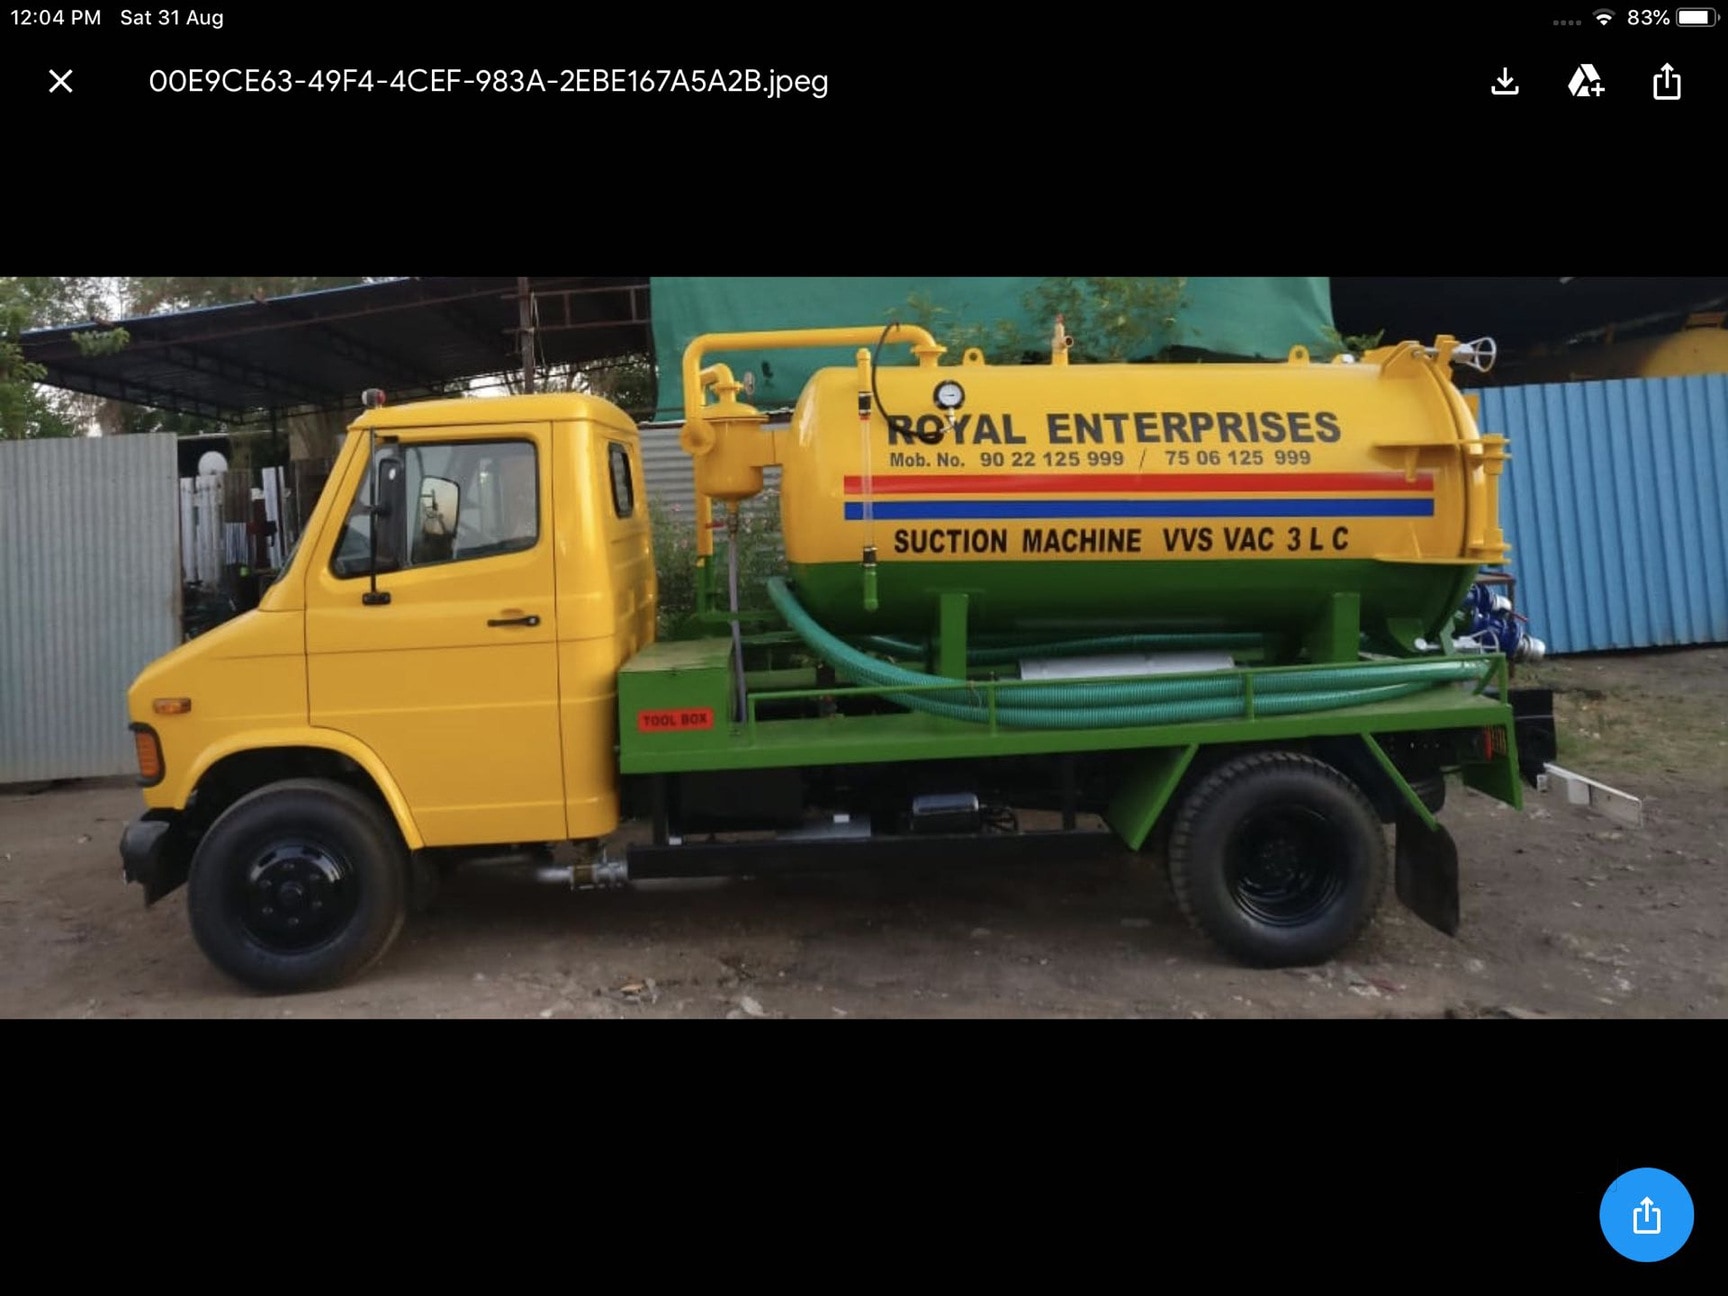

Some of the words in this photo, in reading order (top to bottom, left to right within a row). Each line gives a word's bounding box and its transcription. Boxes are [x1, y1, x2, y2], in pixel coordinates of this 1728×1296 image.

[888, 413, 1027, 445] ROYAL
[1047, 412, 1340, 444] ENTERPRISES
[890, 452, 931, 468] Mob.
[937, 452, 965, 467] No.
[980, 452, 1005, 467] 90
[1012, 451, 1035, 467] 22
[1043, 451, 1080, 467] 125
[1087, 451, 1124, 466] 999
[1165, 450, 1190, 466] 75
[1196, 450, 1221, 465] 06
[1228, 450, 1263, 465] 125
[1274, 450, 1311, 465] 999
[894, 528, 1007, 554] SUCTION
[1022, 528, 1142, 554] MACHINE
[1163, 527, 1213, 552] VVS
[1223, 527, 1274, 552] VAC
[1287, 527, 1301, 552] 3
[1310, 527, 1324, 552] L
[1332, 526, 1348, 552] C
[643, 715, 677, 727] TOOL
[681, 713, 707, 725] BOX
